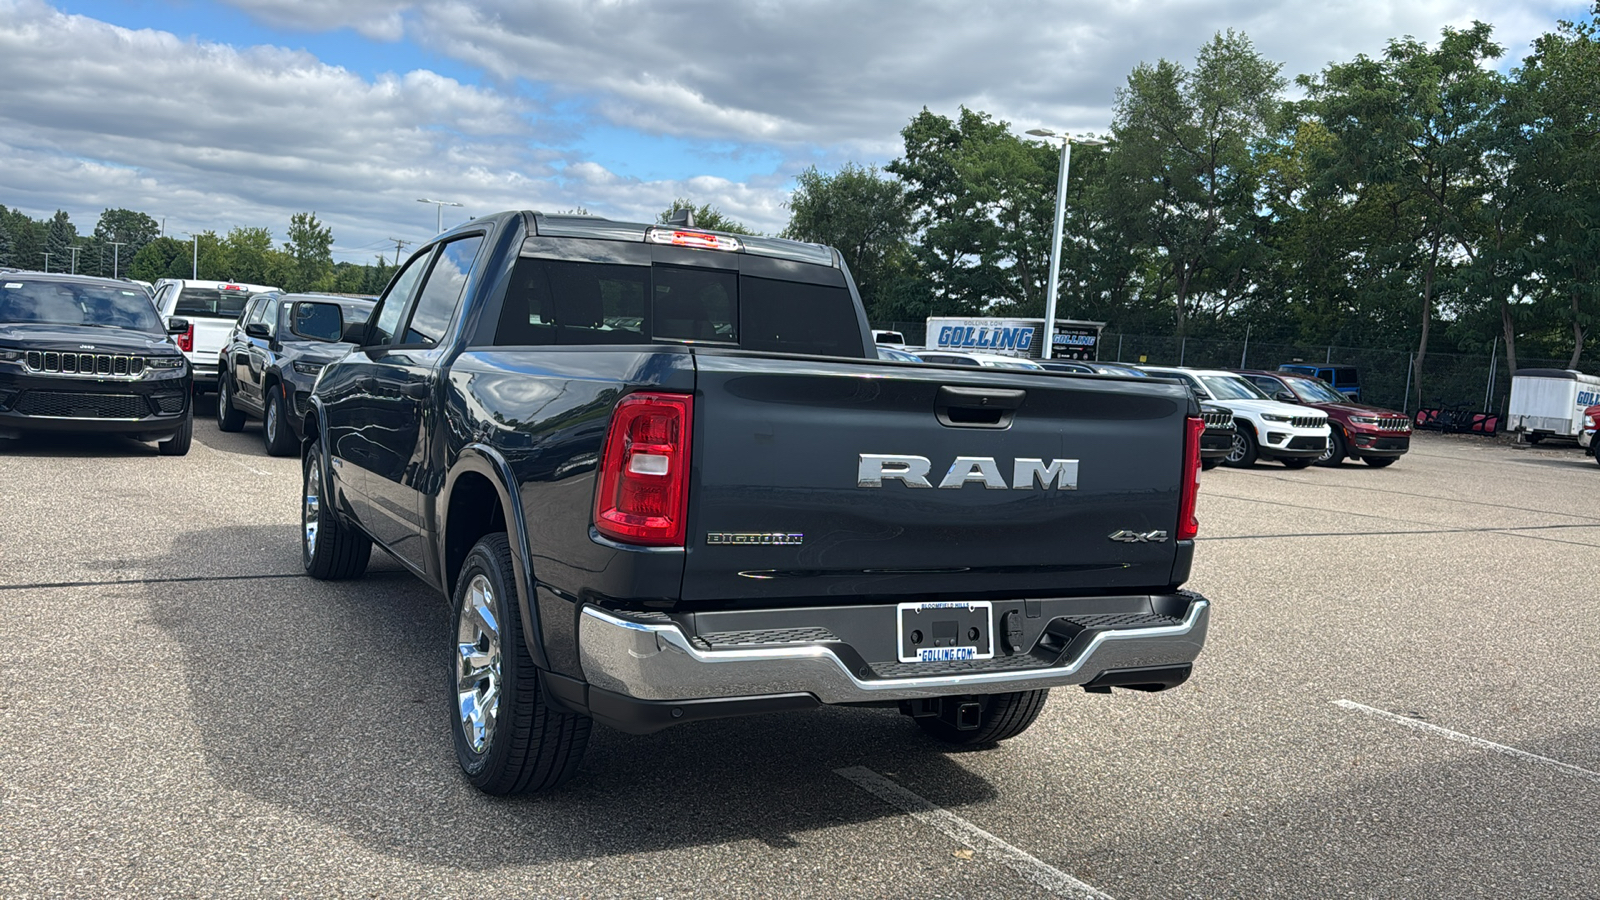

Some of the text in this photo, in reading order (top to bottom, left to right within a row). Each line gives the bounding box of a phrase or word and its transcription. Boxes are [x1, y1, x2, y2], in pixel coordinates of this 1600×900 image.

[938, 326, 1034, 350] GOLLING
[1053, 334, 1096, 346] GOLLING
[857, 453, 1080, 490] RAM
[922, 648, 973, 661] GOLLING.COM
